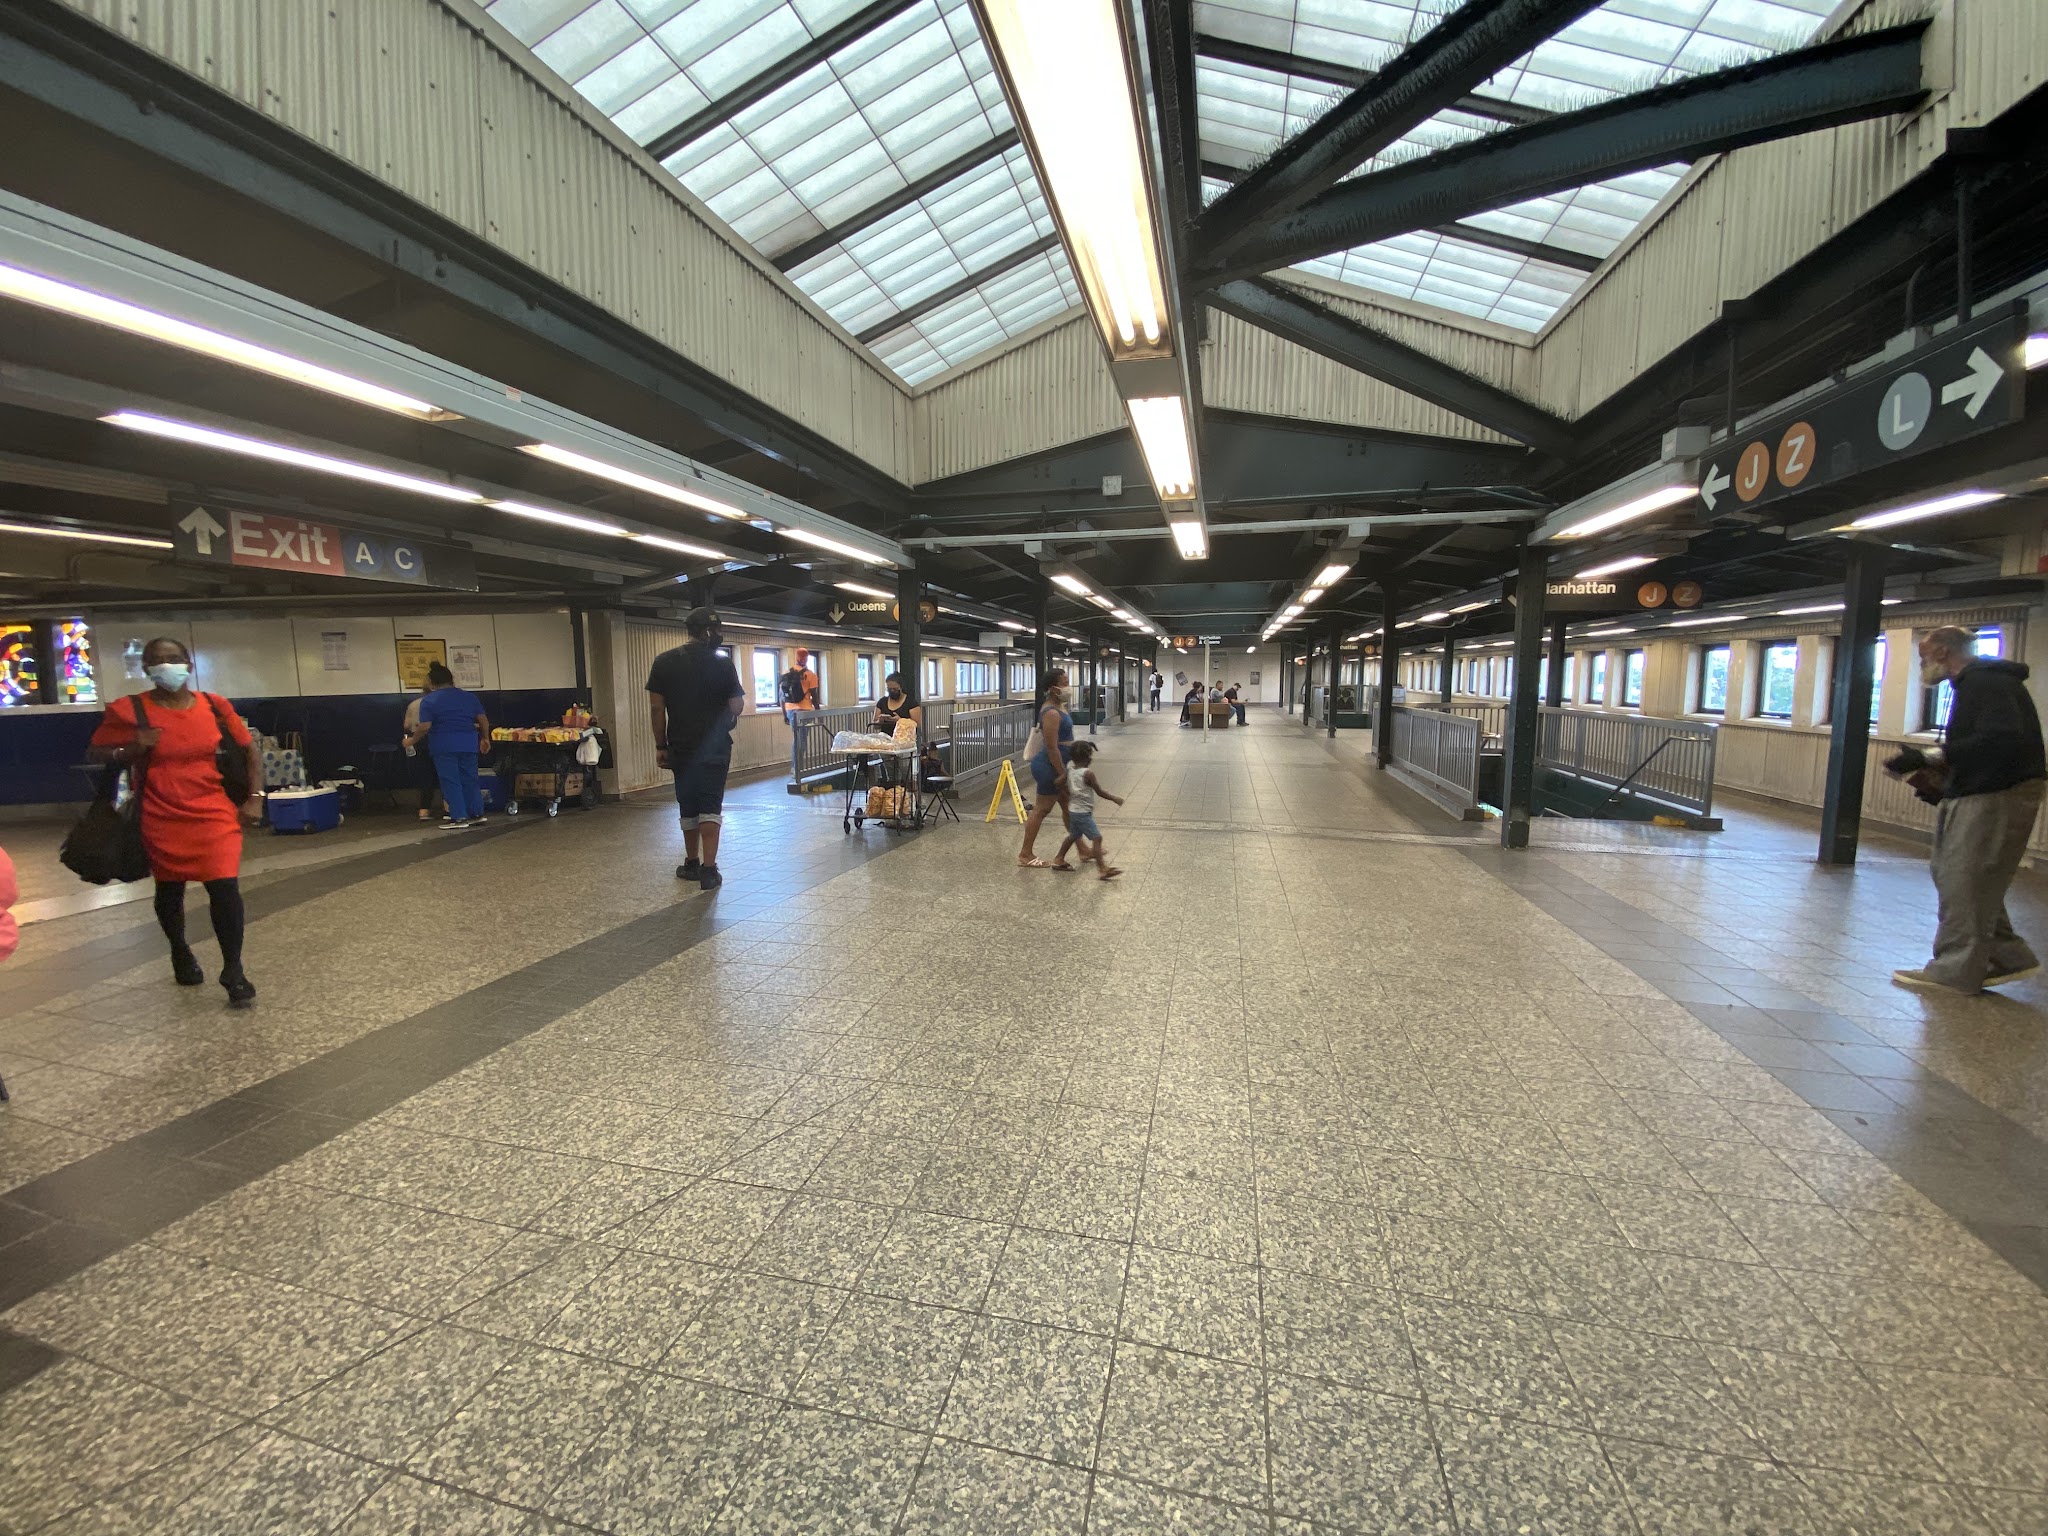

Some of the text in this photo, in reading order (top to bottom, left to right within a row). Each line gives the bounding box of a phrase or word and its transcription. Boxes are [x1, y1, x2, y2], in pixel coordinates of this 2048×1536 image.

[1893, 394, 1914, 435] L
[1744, 434, 1806, 490] J Z
[230, 511, 414, 571] Exit A C
[847, 601, 887, 612] Queens
[1645, 587, 1658, 603] J
[1679, 587, 1695, 602] Z
[1176, 638, 1182, 646] J
[1187, 638, 1194, 646] Z
